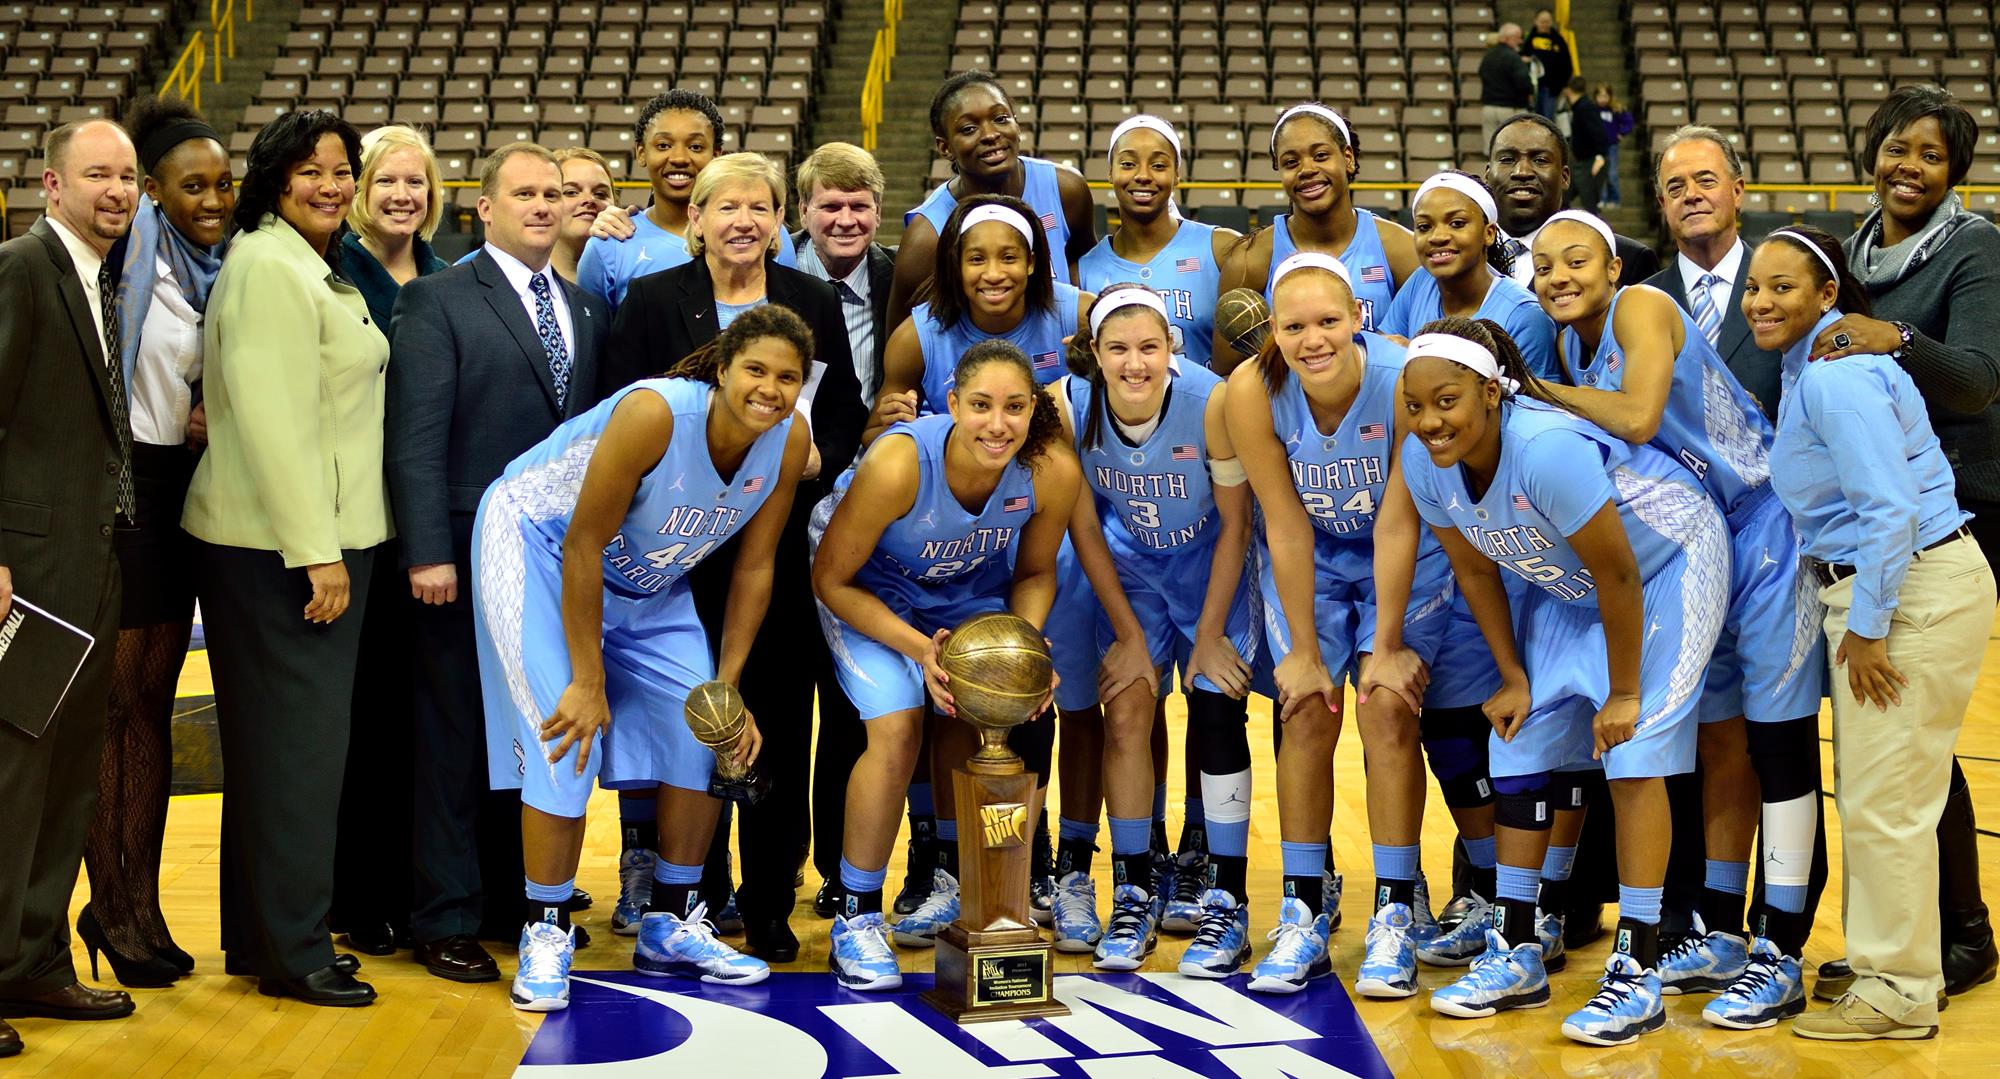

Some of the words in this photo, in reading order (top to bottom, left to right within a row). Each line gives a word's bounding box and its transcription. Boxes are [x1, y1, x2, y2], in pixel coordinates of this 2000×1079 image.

[1096, 466, 1188, 499] NORTH
[1290, 457, 1384, 490] NORTH
[1127, 499, 1162, 528] 3
[1301, 488, 1376, 519] 24
[642, 539, 718, 570] 44
[918, 526, 1013, 560] NORTH
[602, 532, 676, 592] CAROL
